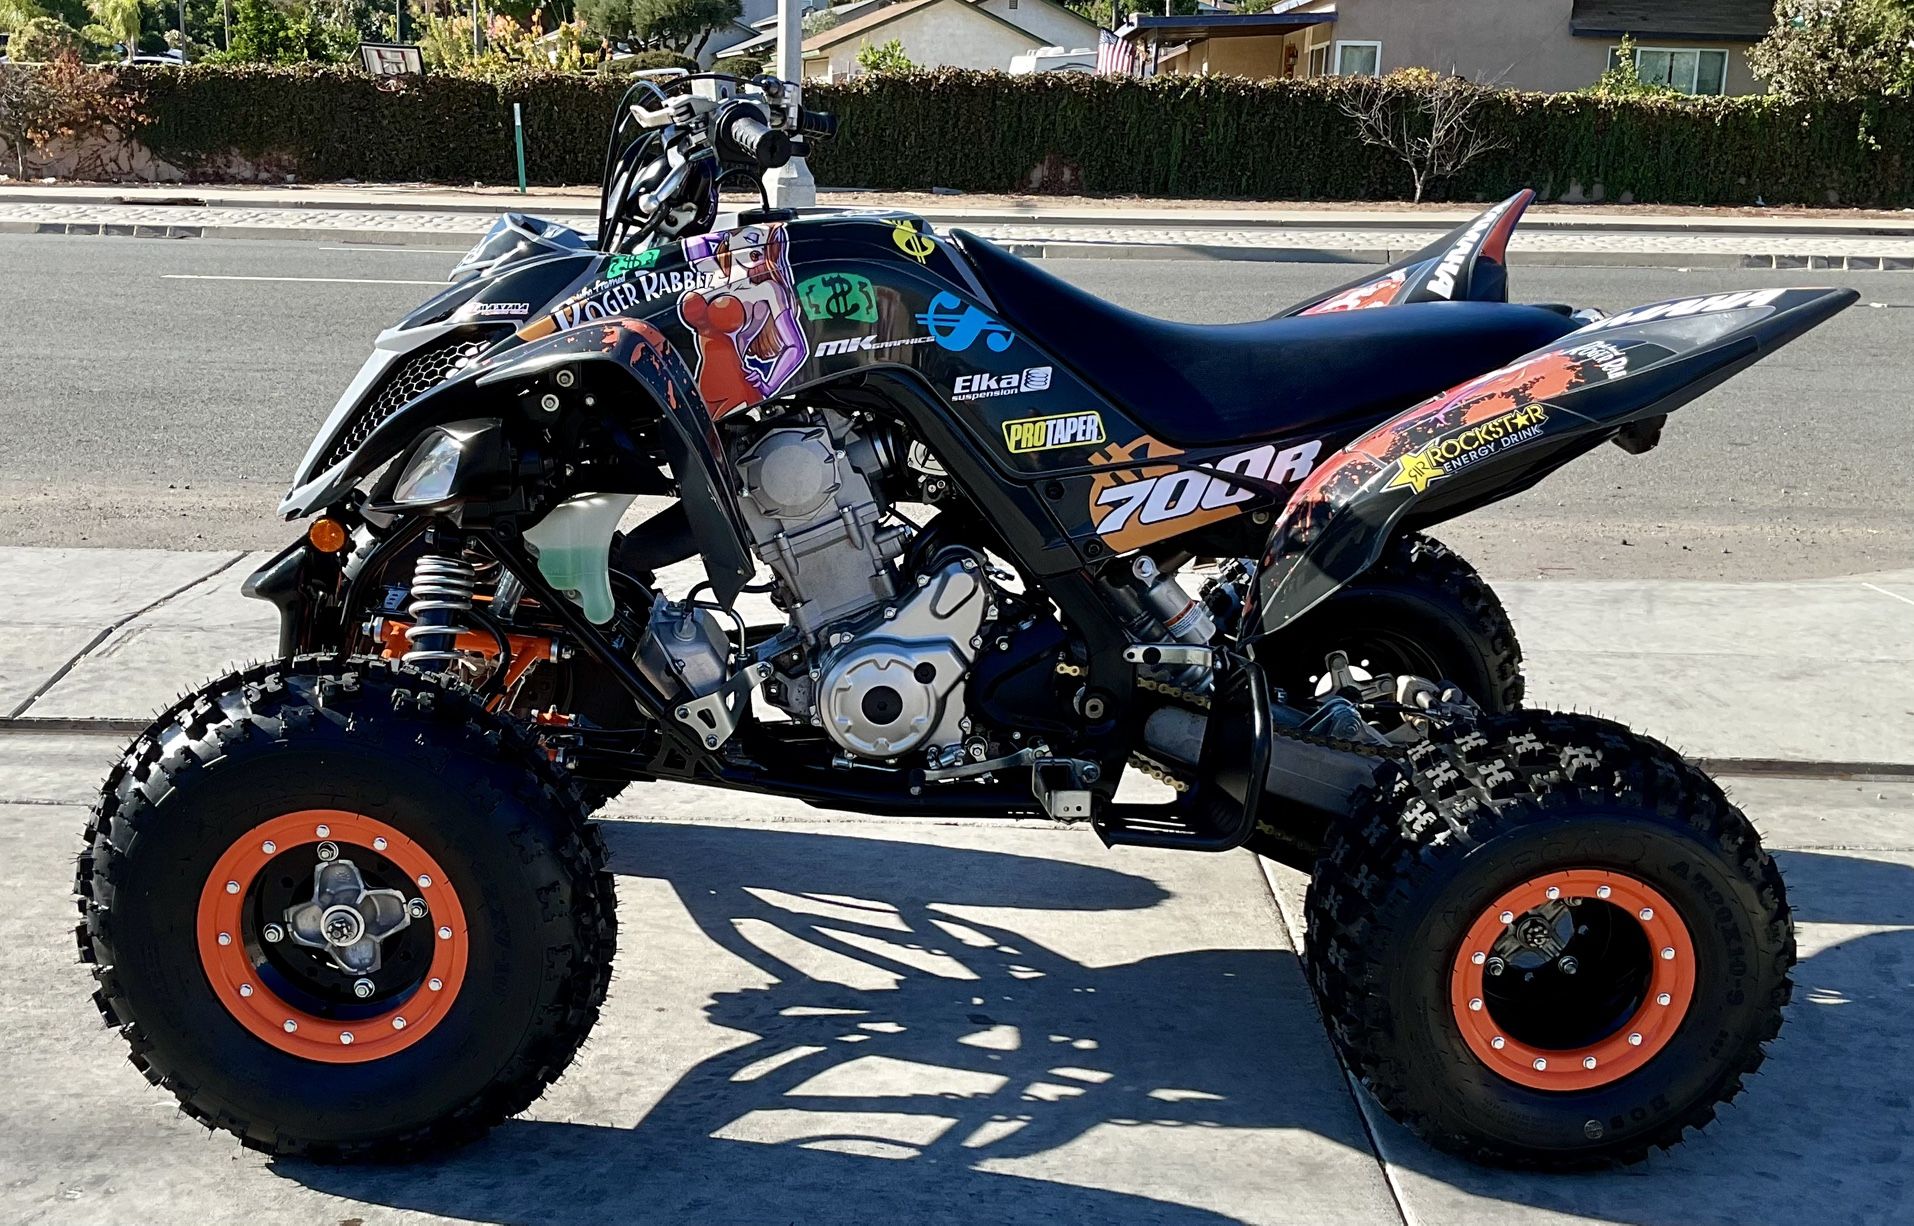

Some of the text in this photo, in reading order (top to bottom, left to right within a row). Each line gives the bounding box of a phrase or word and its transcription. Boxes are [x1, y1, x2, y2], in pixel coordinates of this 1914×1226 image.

[951, 388, 1019, 402] suspension
[953, 372, 1020, 395] Elka
[1443, 424, 1541, 473] ENERGY DRINK
